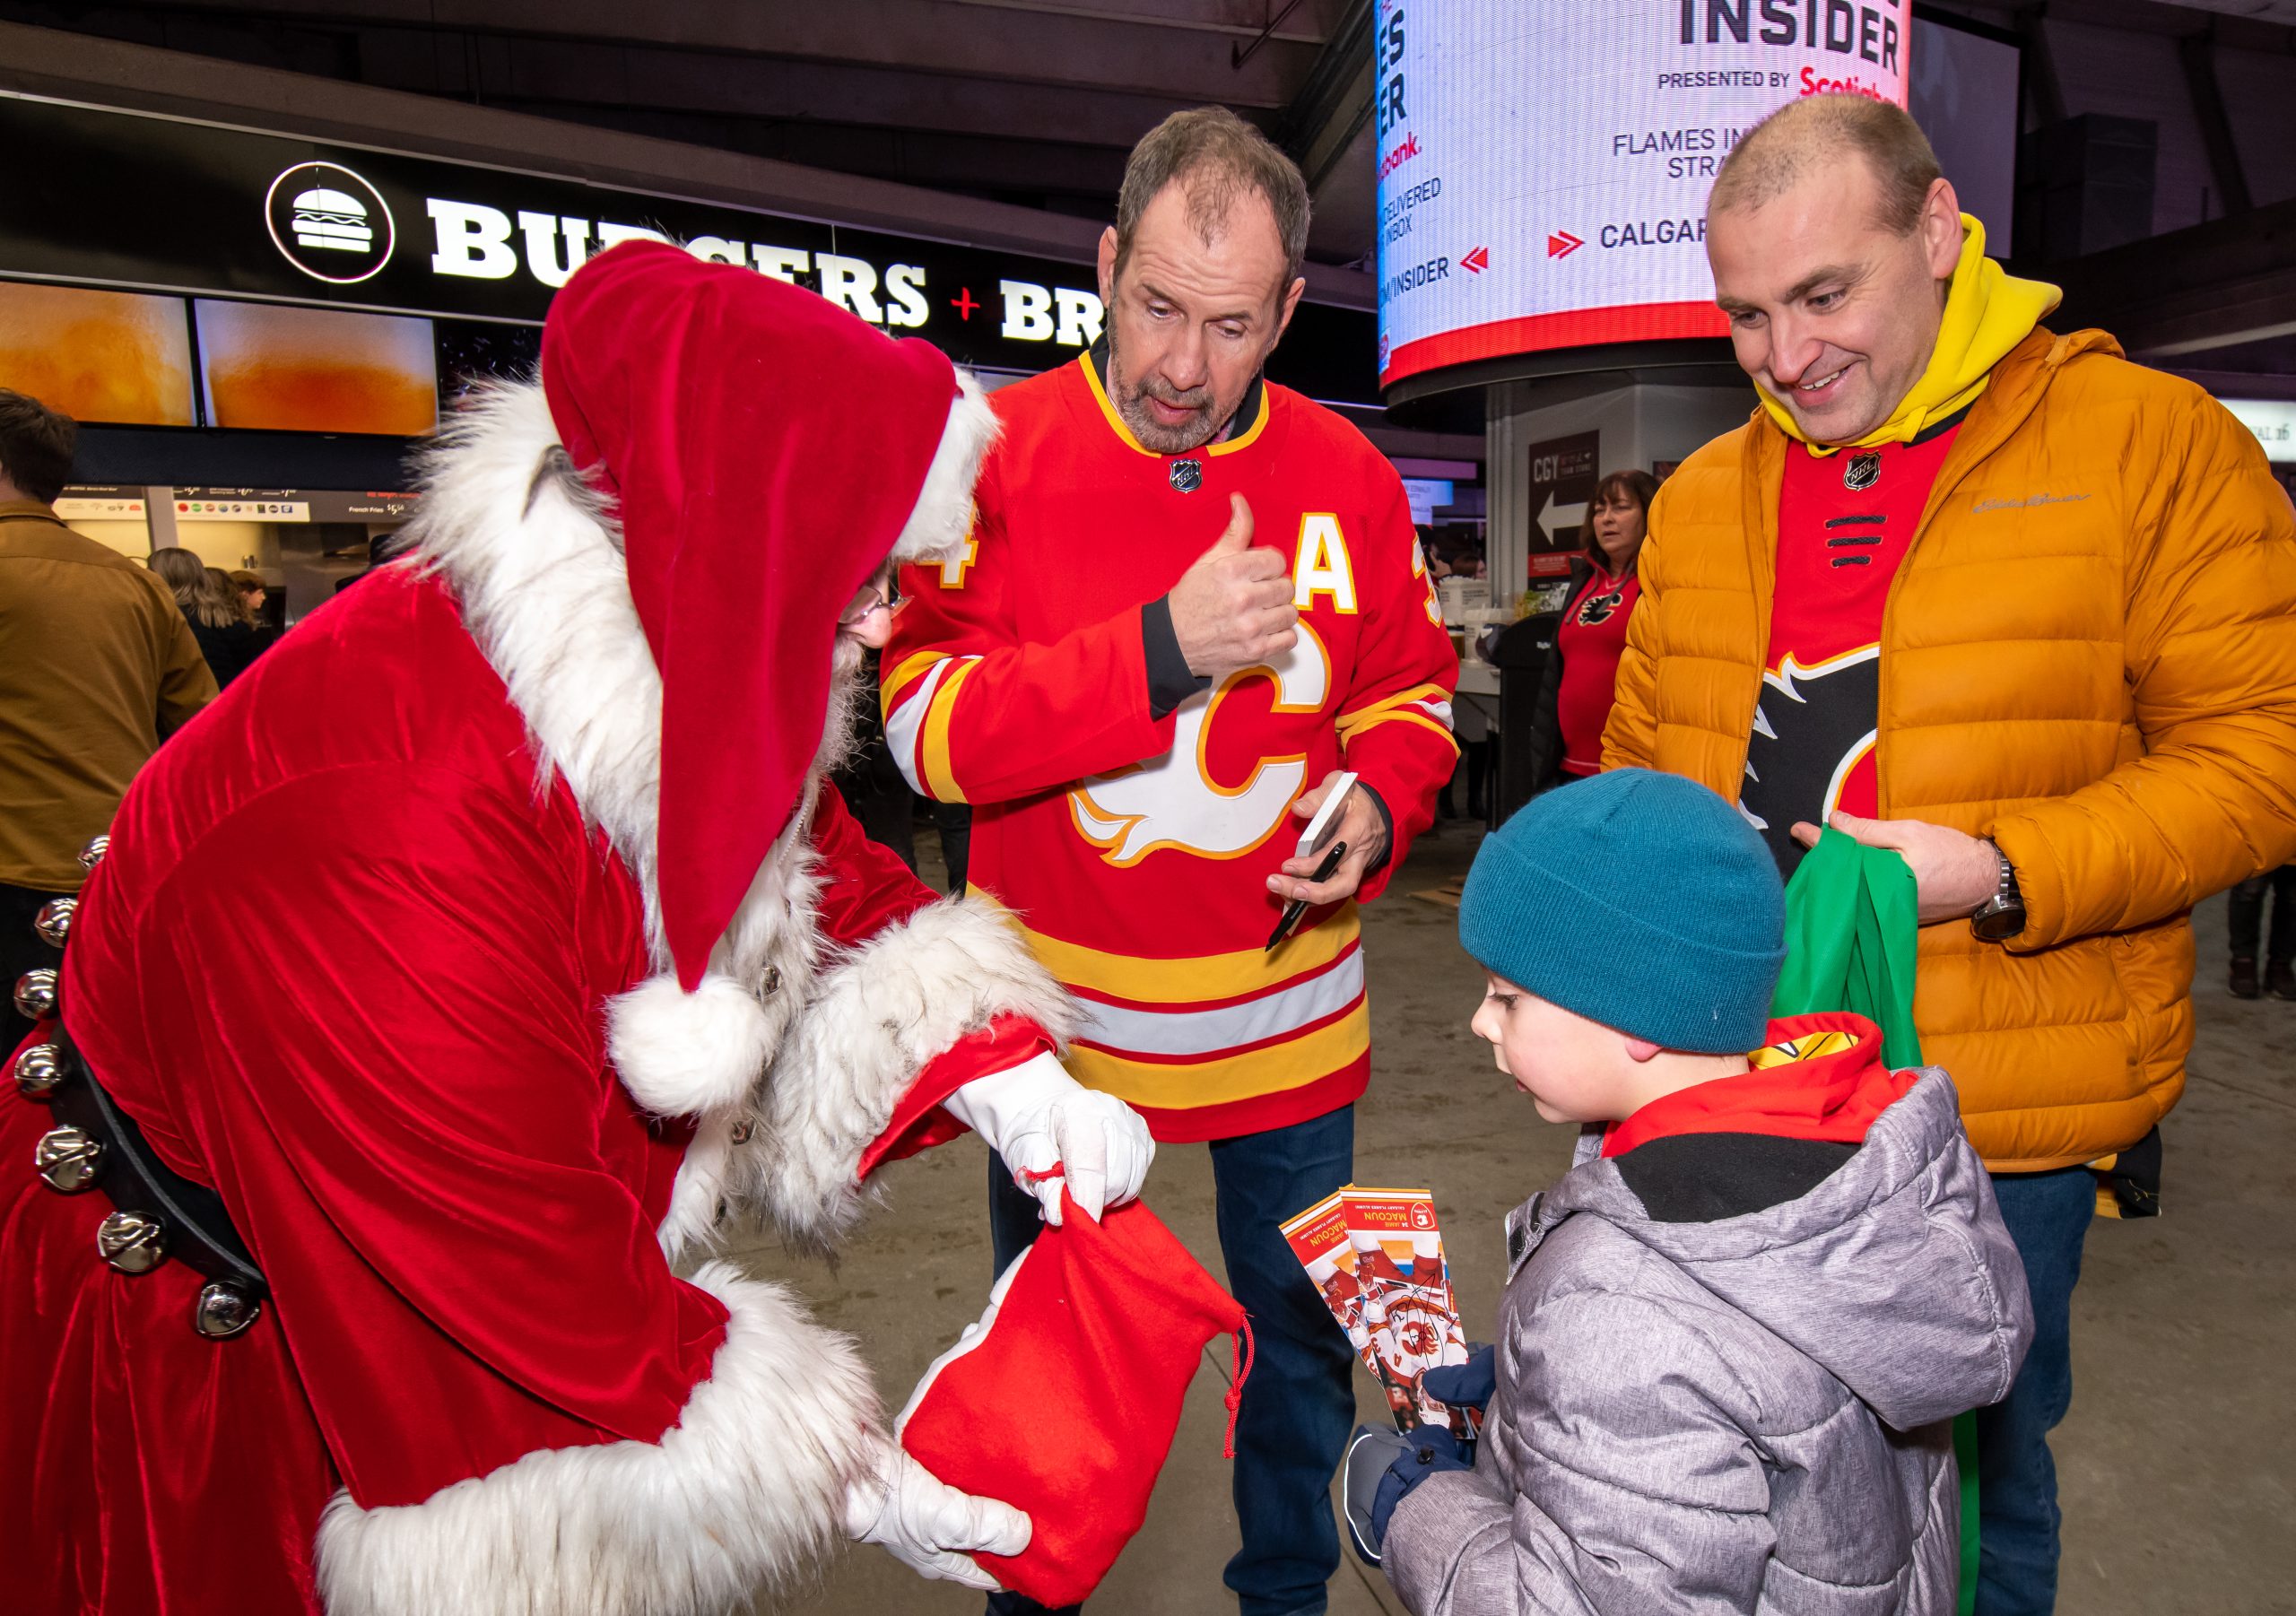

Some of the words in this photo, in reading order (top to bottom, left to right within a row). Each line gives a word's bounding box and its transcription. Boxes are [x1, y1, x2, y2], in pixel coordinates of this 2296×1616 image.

[1680, 0, 1899, 77] INSIDER
[1658, 71, 1764, 89] PRESENTED
[1770, 73, 1790, 88] BY
[1613, 128, 1715, 156] FLAMES
[1384, 177, 1441, 226] DELIVERED
[1534, 455, 1559, 482] CGY
[1851, 461, 1874, 482] NHL
[1292, 512, 1358, 614] A
[1364, 1212, 1407, 1221] MACOUN
[1309, 1220, 1348, 1247] MACOUN
